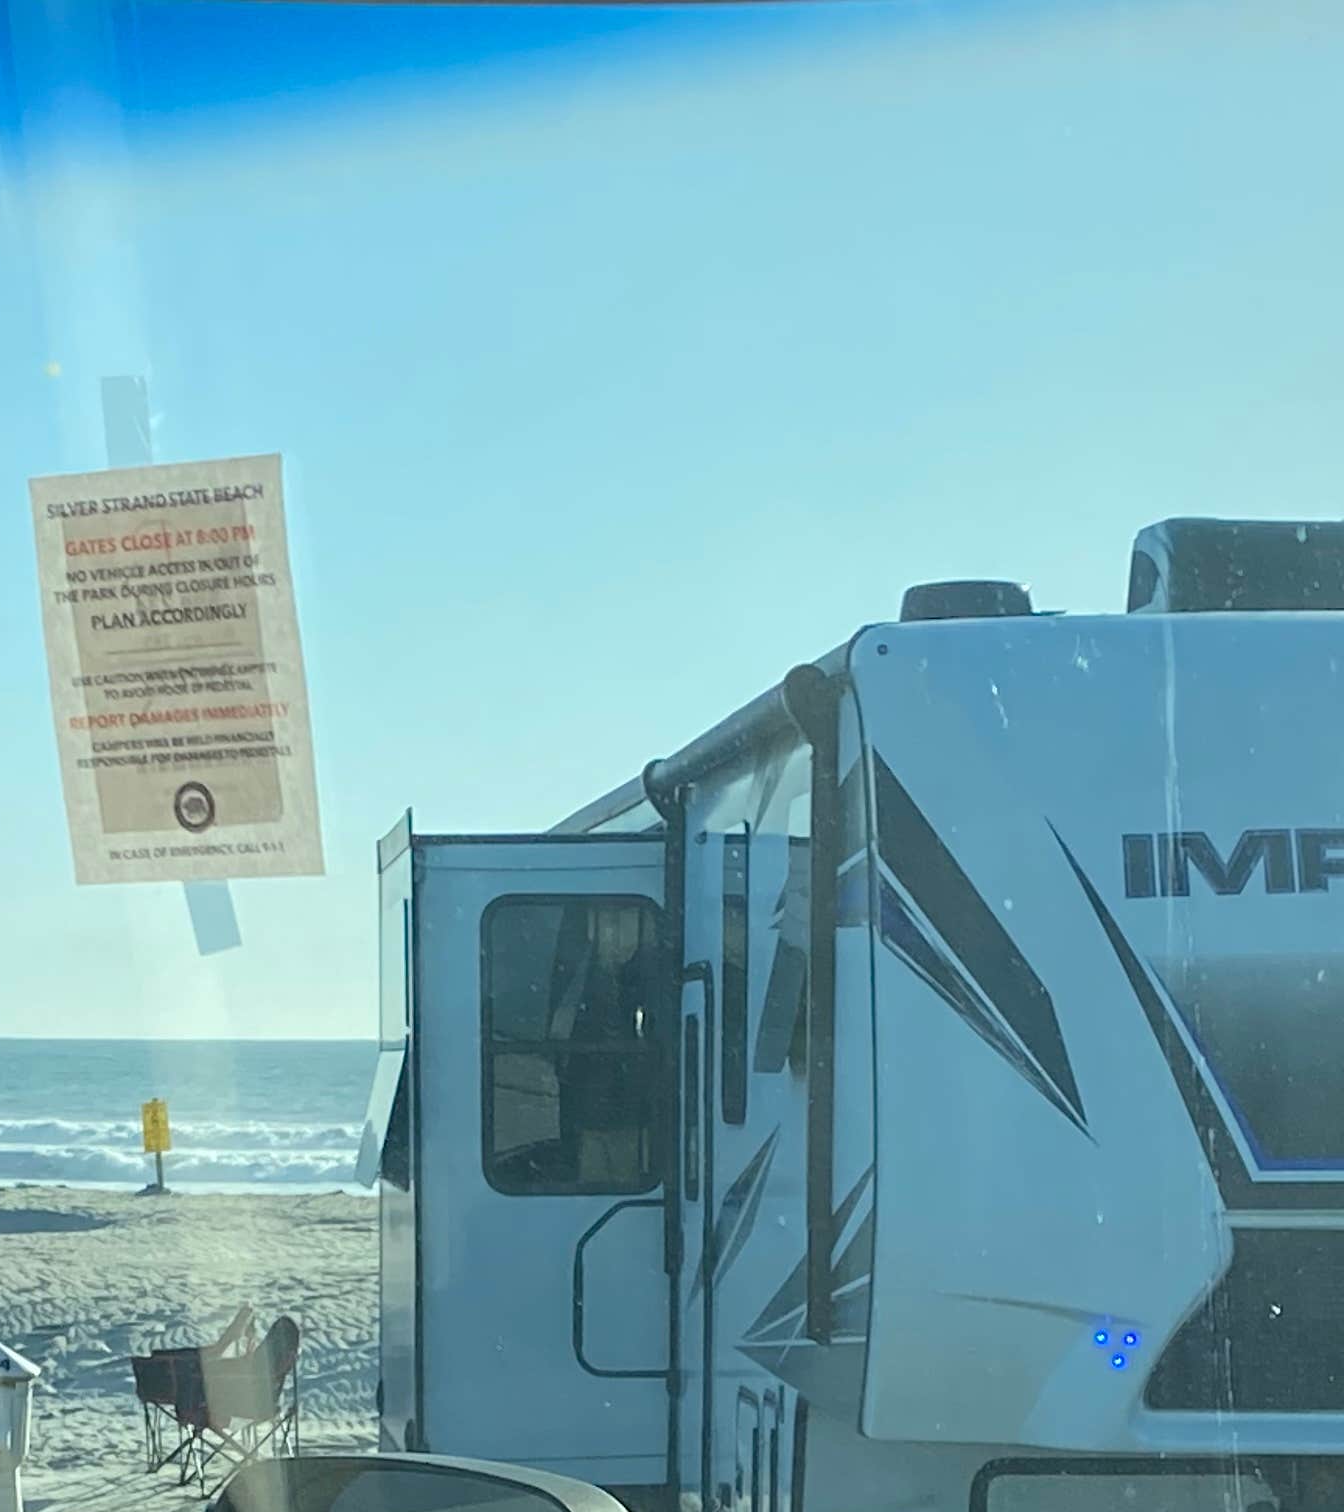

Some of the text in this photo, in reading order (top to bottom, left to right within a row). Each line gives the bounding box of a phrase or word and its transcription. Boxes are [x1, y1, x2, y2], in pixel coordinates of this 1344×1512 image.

[46, 483, 264, 519] SILVER STRAND STATE BEACH
[65, 537, 117, 557] GATES
[121, 532, 172, 552] CLOSE
[176, 529, 194, 547] AT
[66, 569, 87, 585] NO
[90, 565, 145, 582] VEHICLE
[148, 561, 197, 577] ACCESS
[54, 573, 276, 604] THE PARK DURING CLOSURE HOURS
[91, 603, 248, 631] PLAN ACCORDINGLY
[70, 702, 289, 729] REPORT DAMAGES IMMEDIATELY
[123, 848, 151, 861] CASE
[154, 846, 167, 858] OF
[236, 842, 260, 855] CALL
